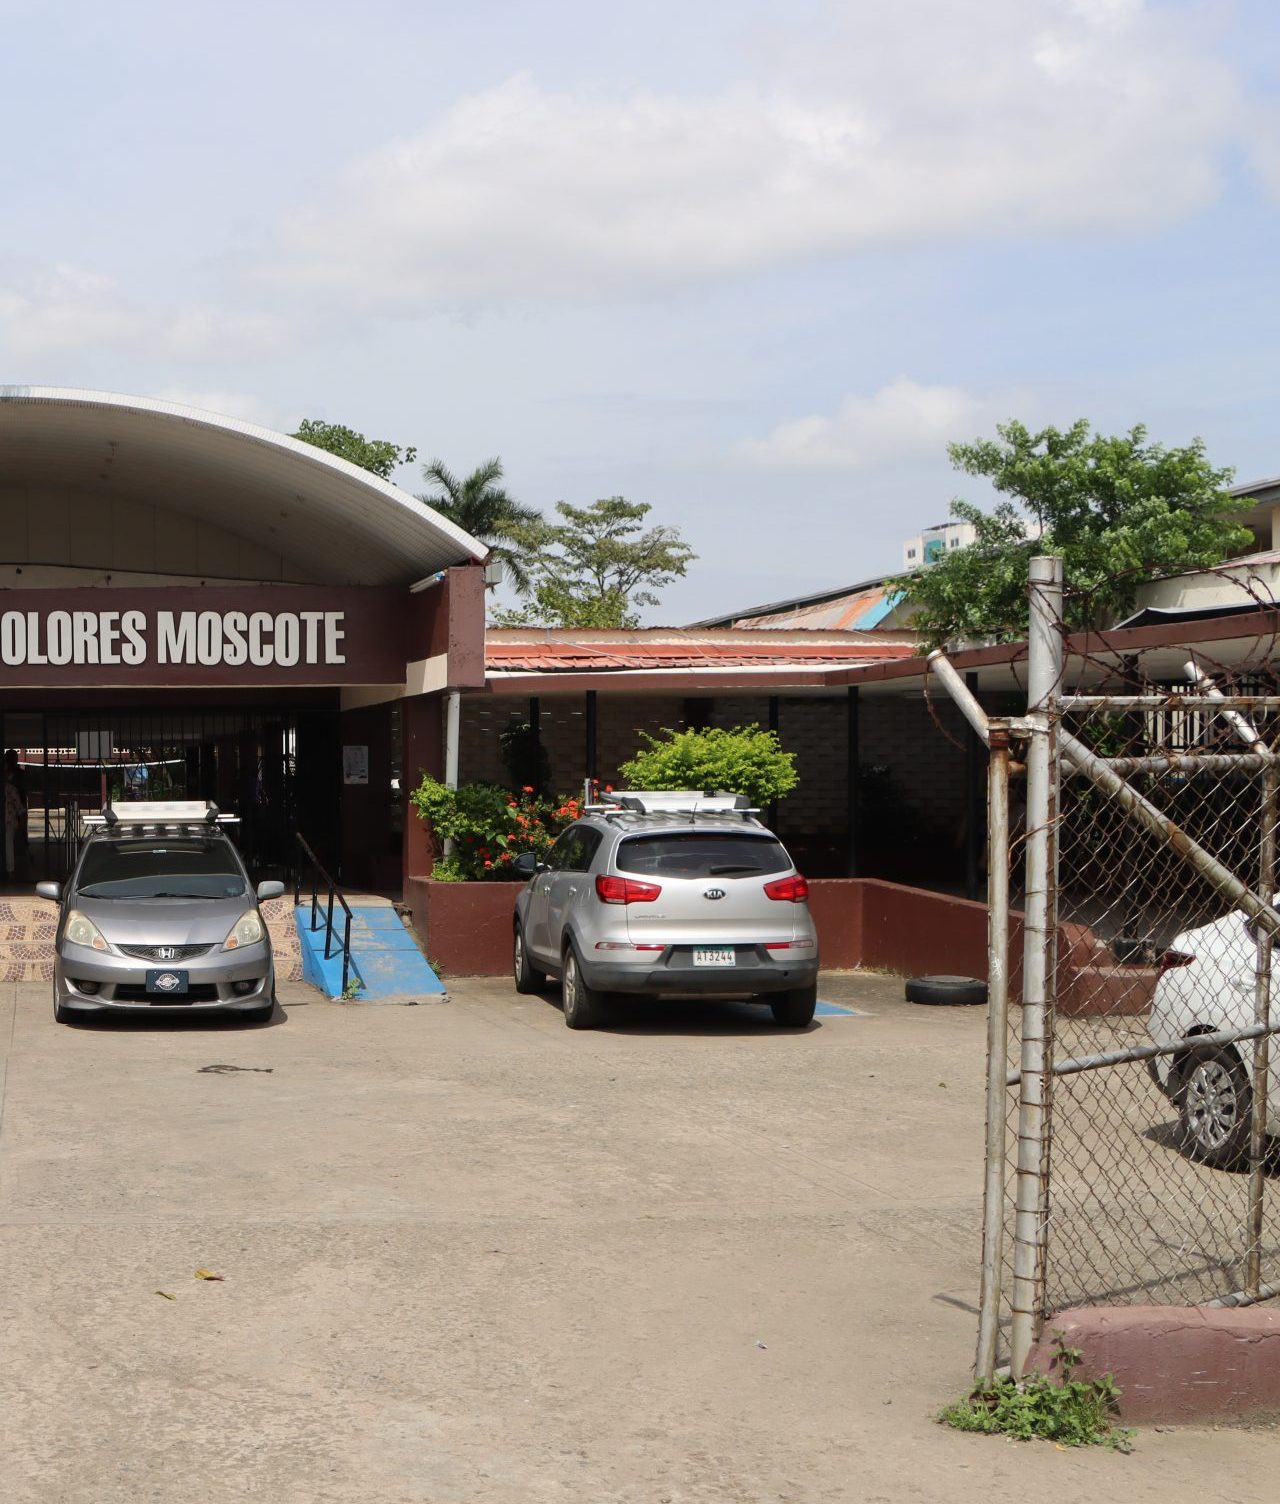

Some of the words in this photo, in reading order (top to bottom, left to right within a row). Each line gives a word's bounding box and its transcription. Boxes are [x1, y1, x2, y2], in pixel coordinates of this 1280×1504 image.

[157, 611, 346, 667] MOSCOTE
[706, 890, 724, 898] KIA
[696, 950, 732, 962] AT3244
